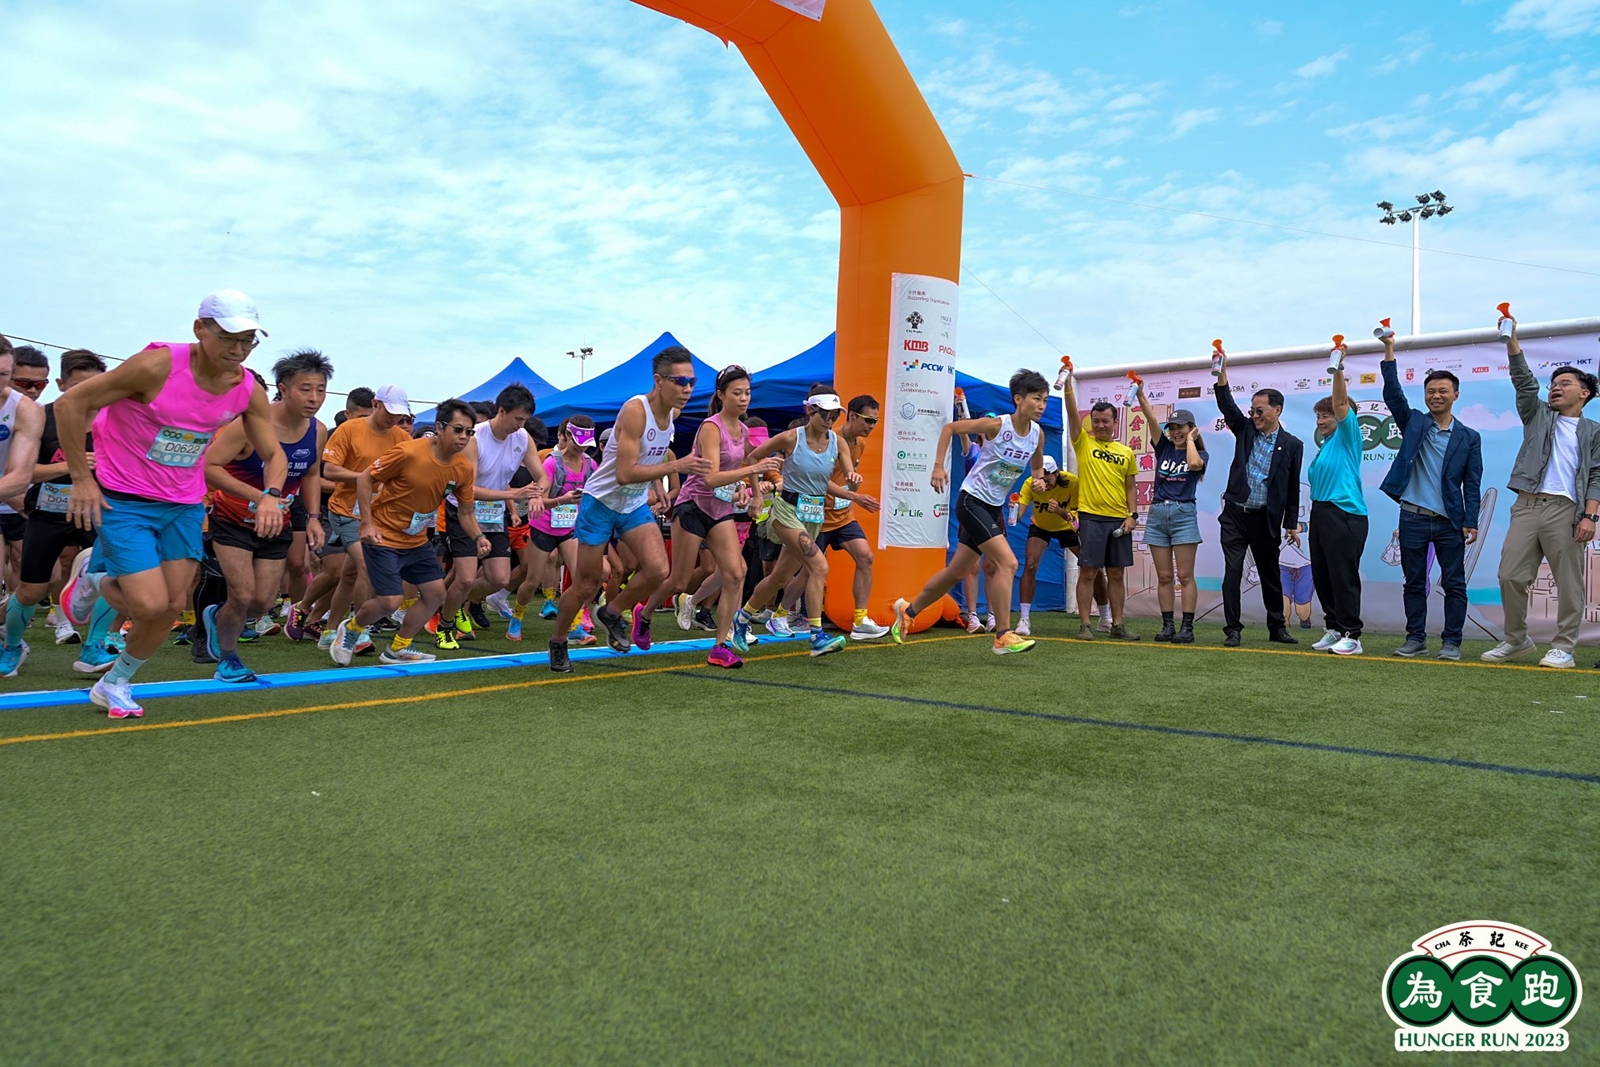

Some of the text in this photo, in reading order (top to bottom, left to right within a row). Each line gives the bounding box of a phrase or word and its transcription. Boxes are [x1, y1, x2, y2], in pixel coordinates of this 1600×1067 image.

[904, 340, 929, 352] KMB
[1576, 358, 1593, 366] HKT
[920, 362, 944, 372] PCCW
[1472, 366, 1490, 374] KMB
[164, 442, 201, 454] D0622
[1363, 453, 1385, 461] RUN
[294, 462, 308, 470] MAN
[47, 495, 68, 503] D04
[909, 509, 924, 518] Life
